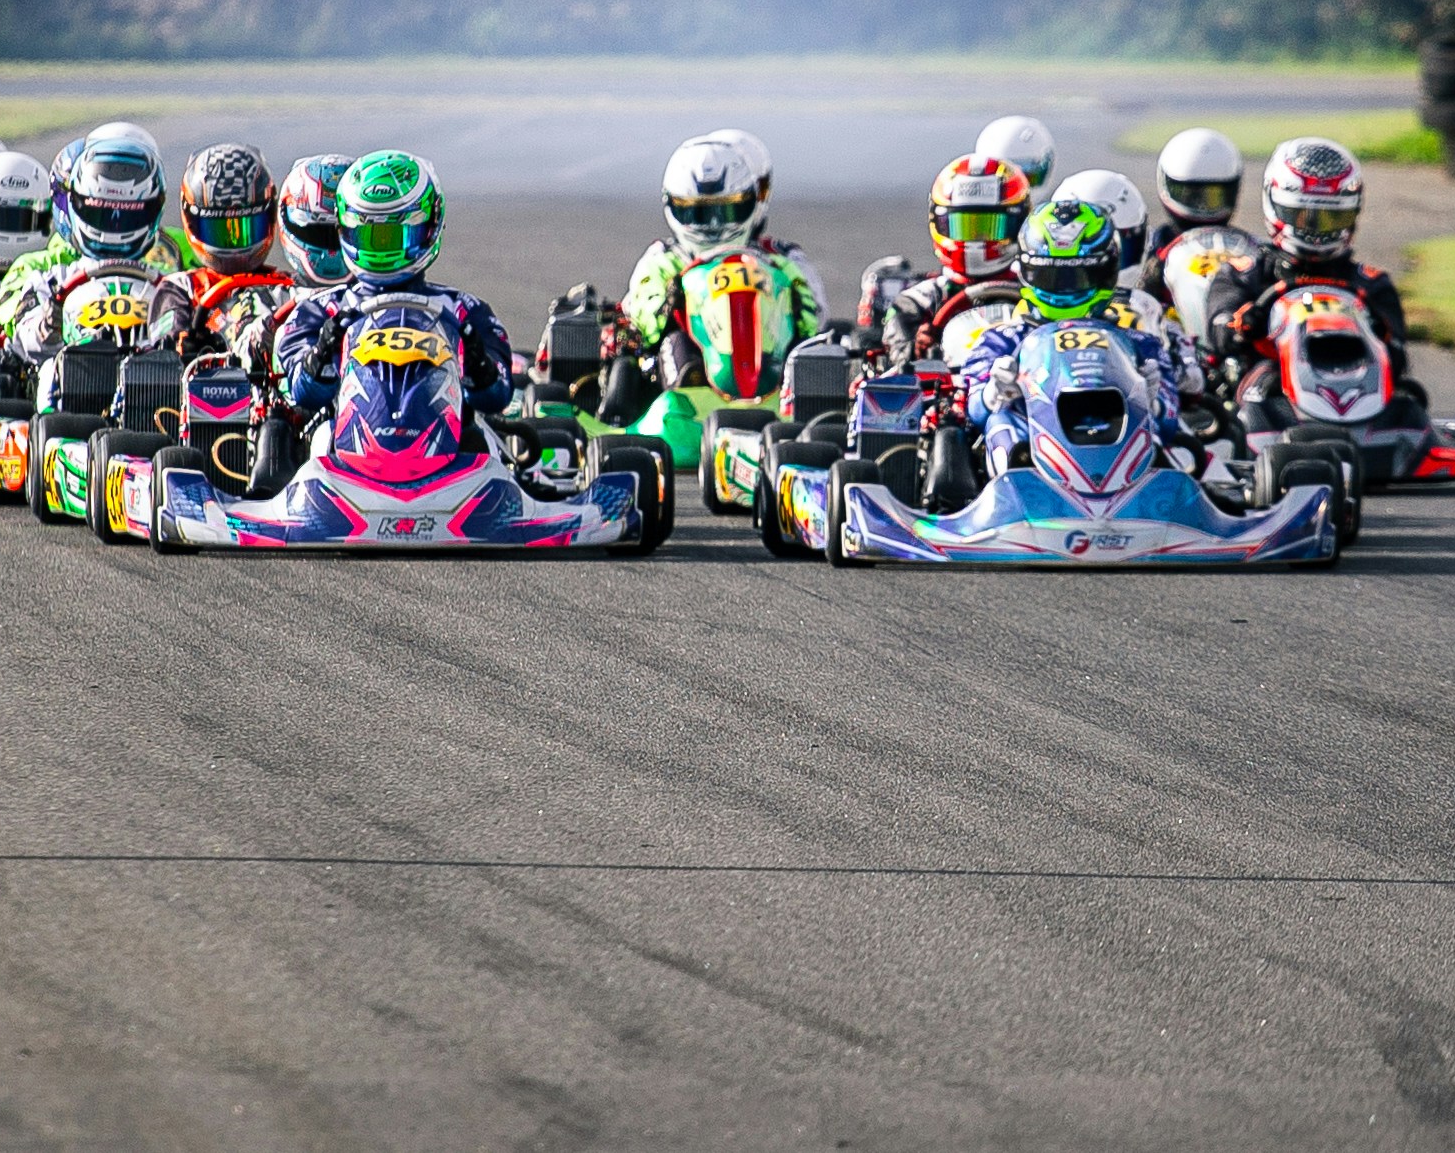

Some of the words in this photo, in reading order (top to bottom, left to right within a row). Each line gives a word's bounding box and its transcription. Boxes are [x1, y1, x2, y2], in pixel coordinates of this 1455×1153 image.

[363, 184, 395, 197] Arai
[366, 330, 439, 359] 354
[1059, 331, 1109, 351] 82
[202, 386, 238, 396] ROTAX
